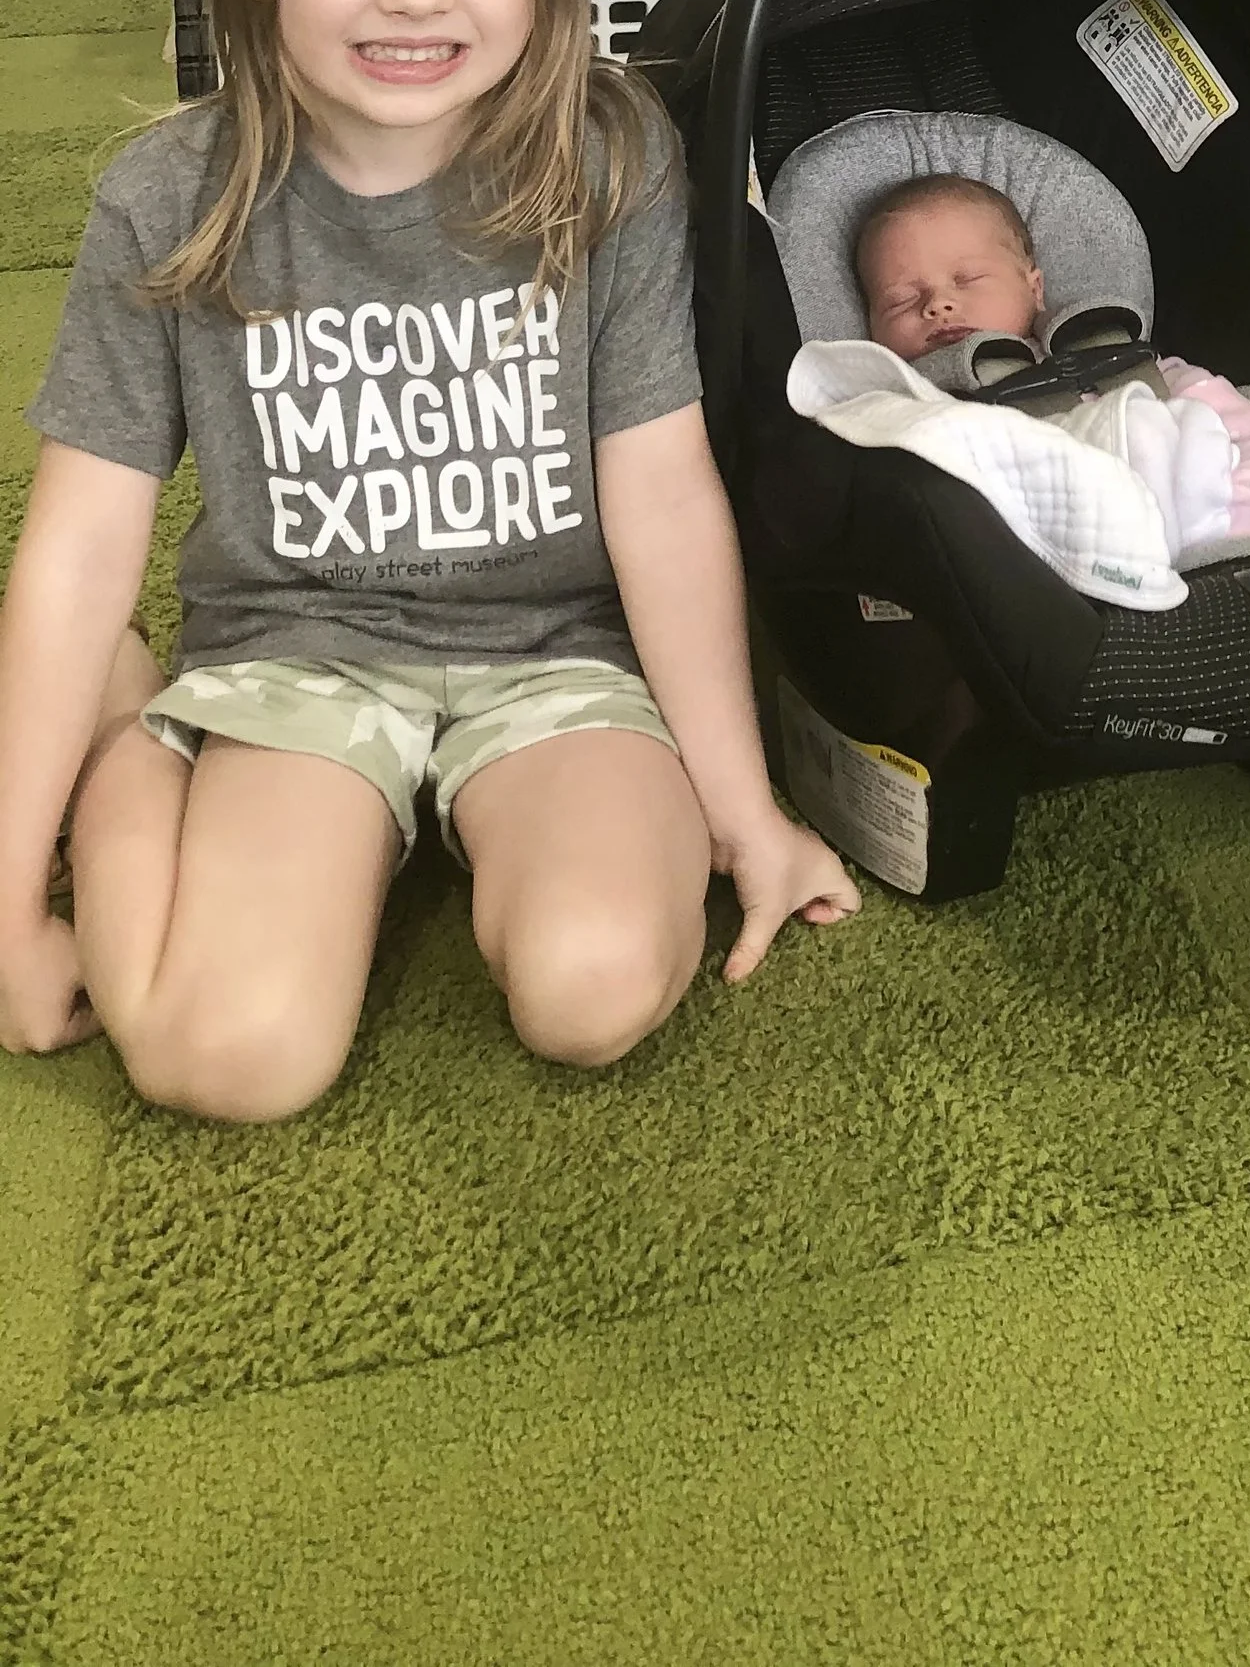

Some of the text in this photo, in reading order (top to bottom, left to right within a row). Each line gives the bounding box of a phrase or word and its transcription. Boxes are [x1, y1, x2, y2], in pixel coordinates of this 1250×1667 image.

[1175, 47, 1224, 115] ADVERTENCIA
[246, 282, 560, 389] DISCOVER
[252, 360, 566, 473] IMAGINE
[268, 452, 583, 558] EXPLORE
[376, 556, 442, 578] street
[452, 550, 538, 574] museum
